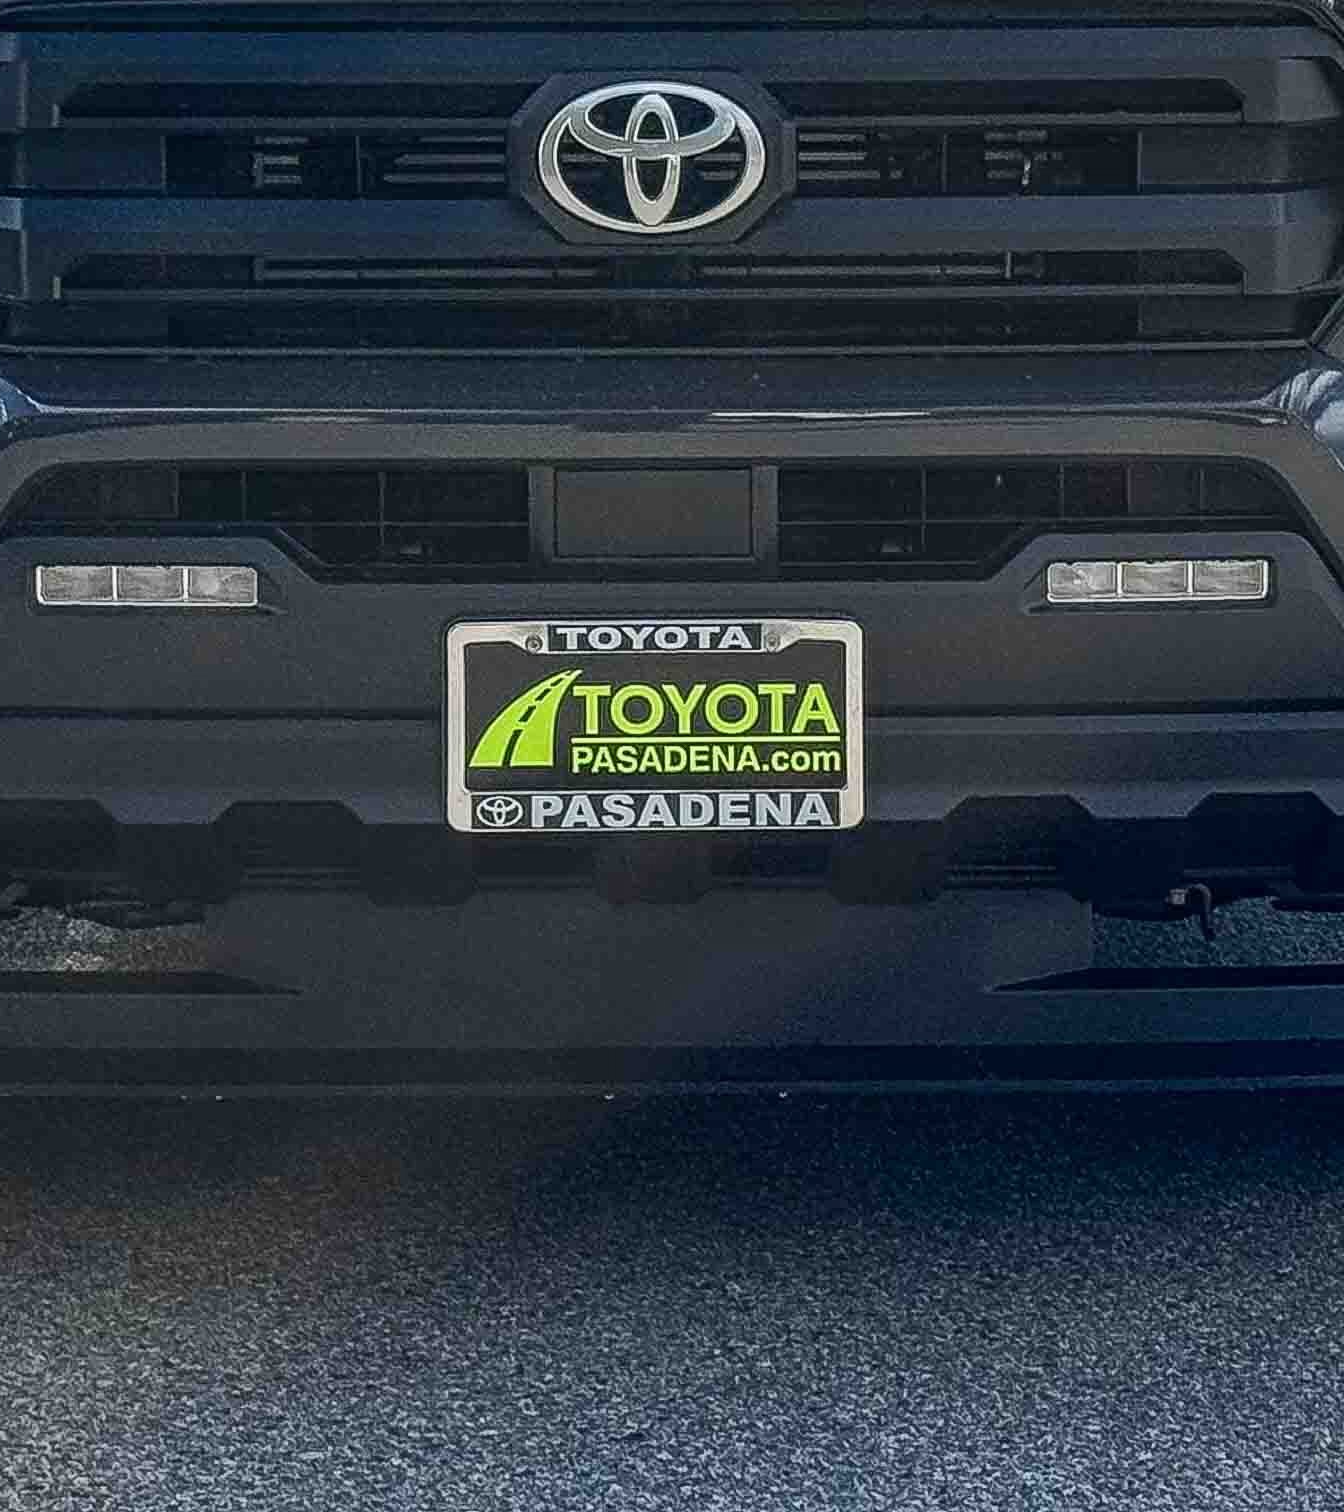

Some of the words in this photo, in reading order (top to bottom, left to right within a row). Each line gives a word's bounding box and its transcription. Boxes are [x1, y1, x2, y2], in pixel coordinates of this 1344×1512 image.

[557, 626, 752, 650] TOYOTA
[573, 683, 841, 736] TOYOTA
[572, 745, 841, 774] PASADENA.com
[530, 793, 834, 828] PASADENA
